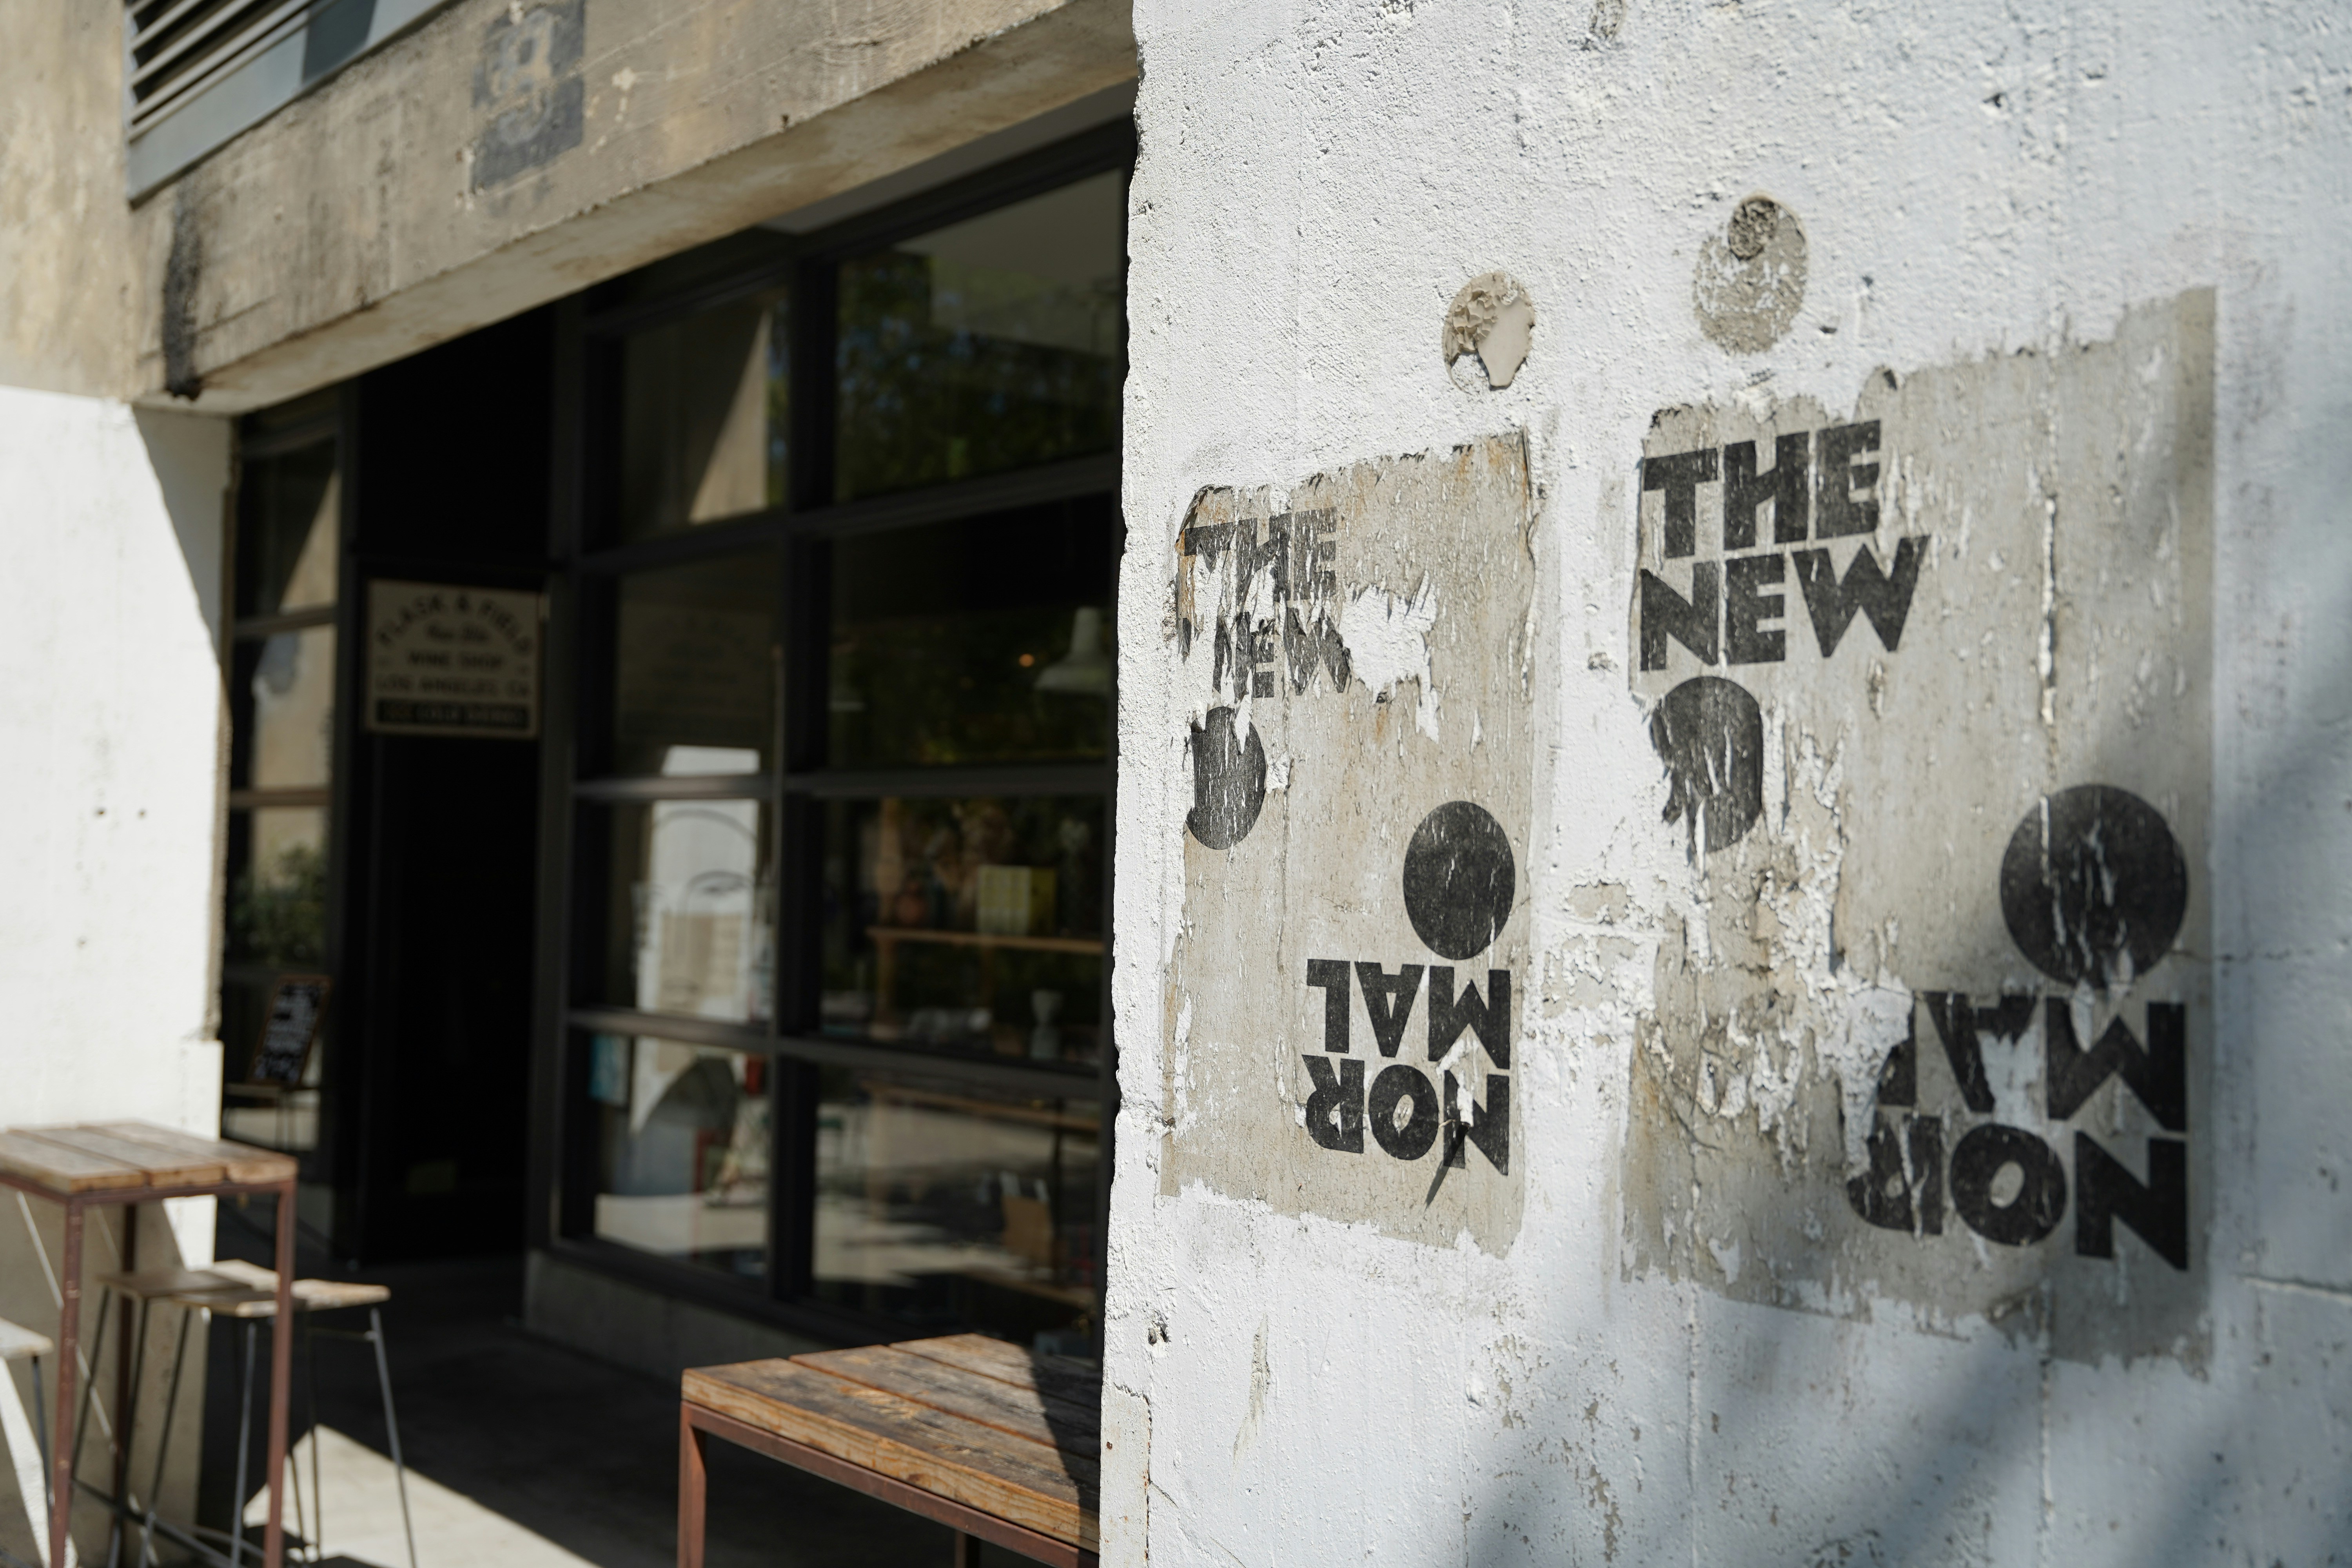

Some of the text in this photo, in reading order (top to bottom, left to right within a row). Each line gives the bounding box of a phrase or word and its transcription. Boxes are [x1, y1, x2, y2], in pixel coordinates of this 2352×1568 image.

[1643, 419, 1881, 559] THE
[1640, 535, 1931, 672] NEW
[1307, 958, 1511, 1070] MAL
[1301, 1054, 1510, 1176] NOR
[1846, 1113, 2188, 1271] NOR
